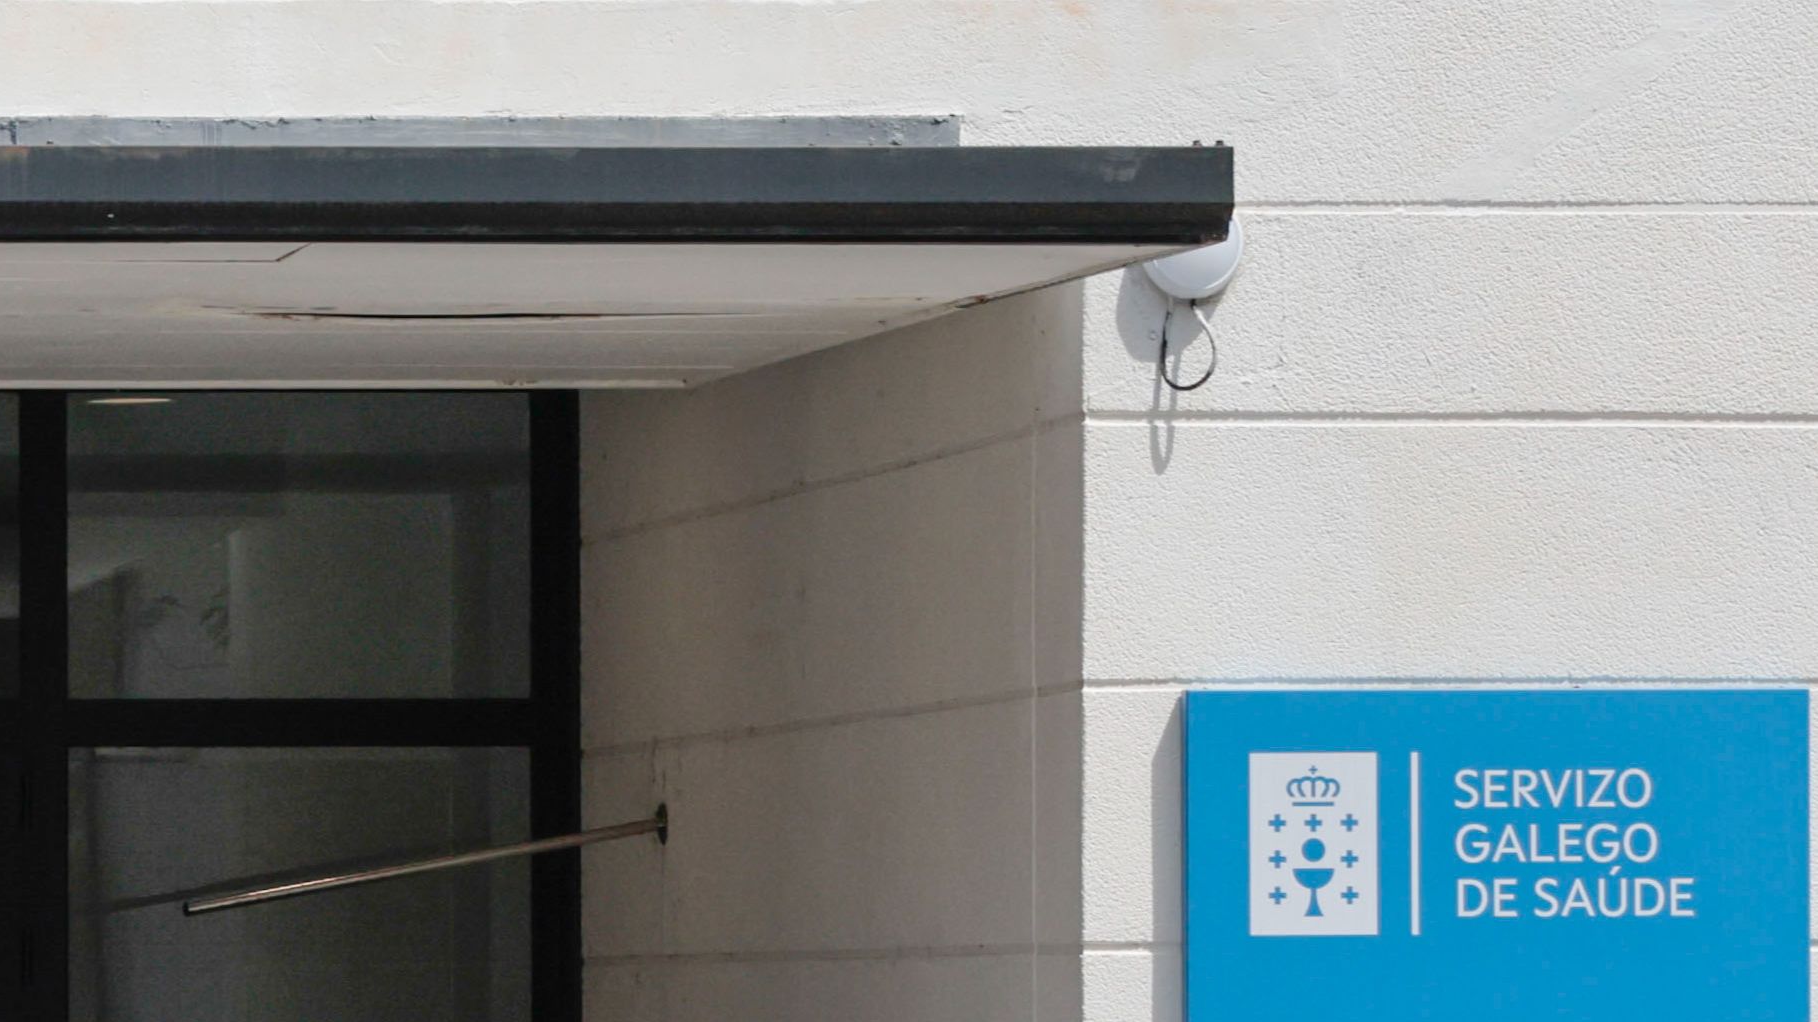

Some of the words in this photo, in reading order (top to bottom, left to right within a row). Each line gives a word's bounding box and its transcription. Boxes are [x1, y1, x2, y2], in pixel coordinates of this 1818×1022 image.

[1454, 767, 1653, 810] SERVIZO
[1454, 822, 1659, 864] GALEGO
[1457, 877, 1519, 918] DE
[1533, 865, 1696, 918] SAÚDE
